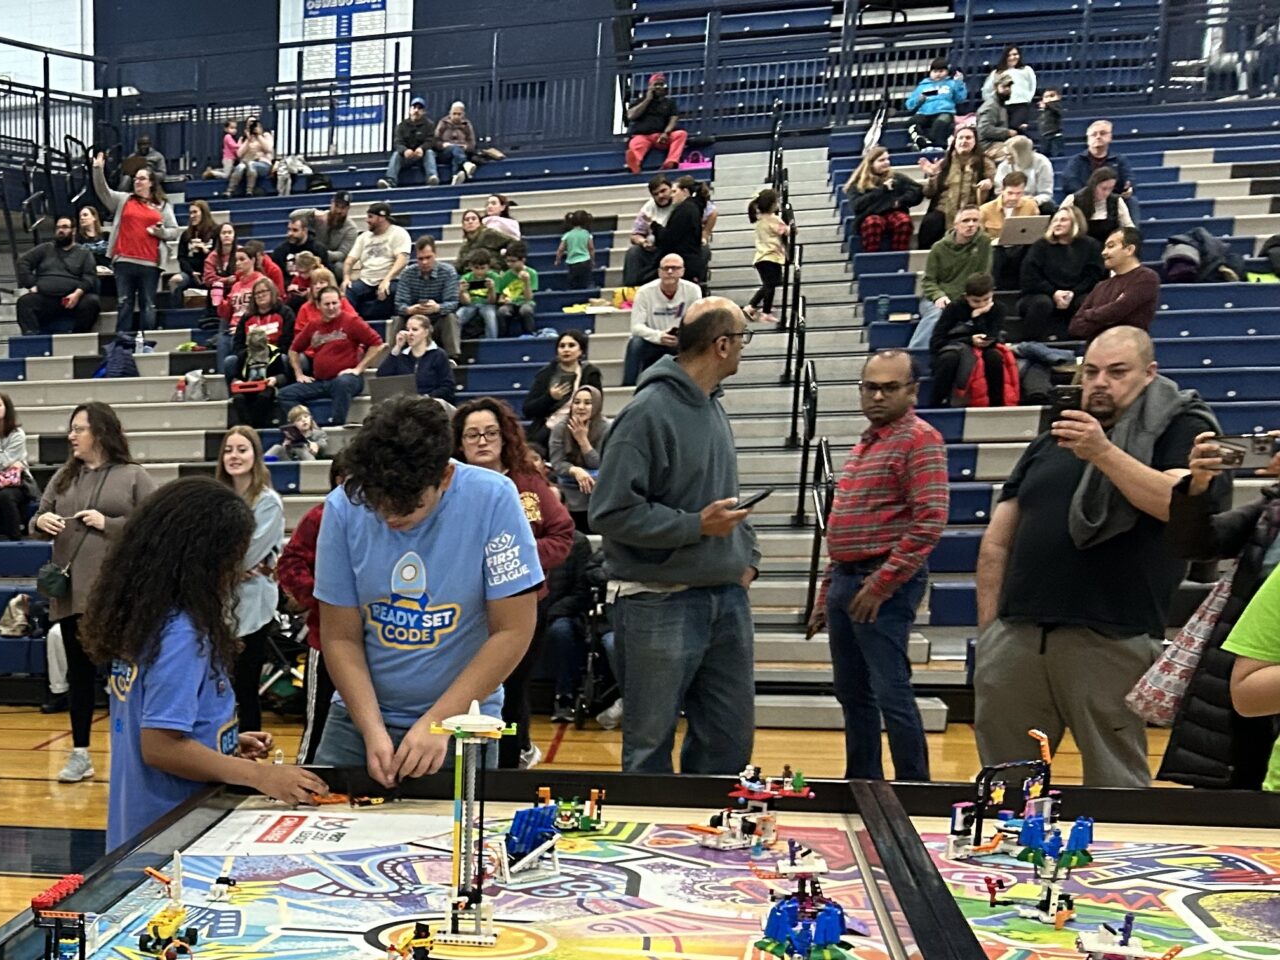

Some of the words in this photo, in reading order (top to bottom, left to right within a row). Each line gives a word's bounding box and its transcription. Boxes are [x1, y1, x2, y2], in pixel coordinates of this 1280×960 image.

[486, 546, 520, 568] FIRST
[490, 559, 520, 576] LEGO
[488, 564, 531, 587] LEAGUE
[372, 604, 420, 627] READY
[422, 611, 453, 628] SET
[384, 624, 431, 642] CODE
